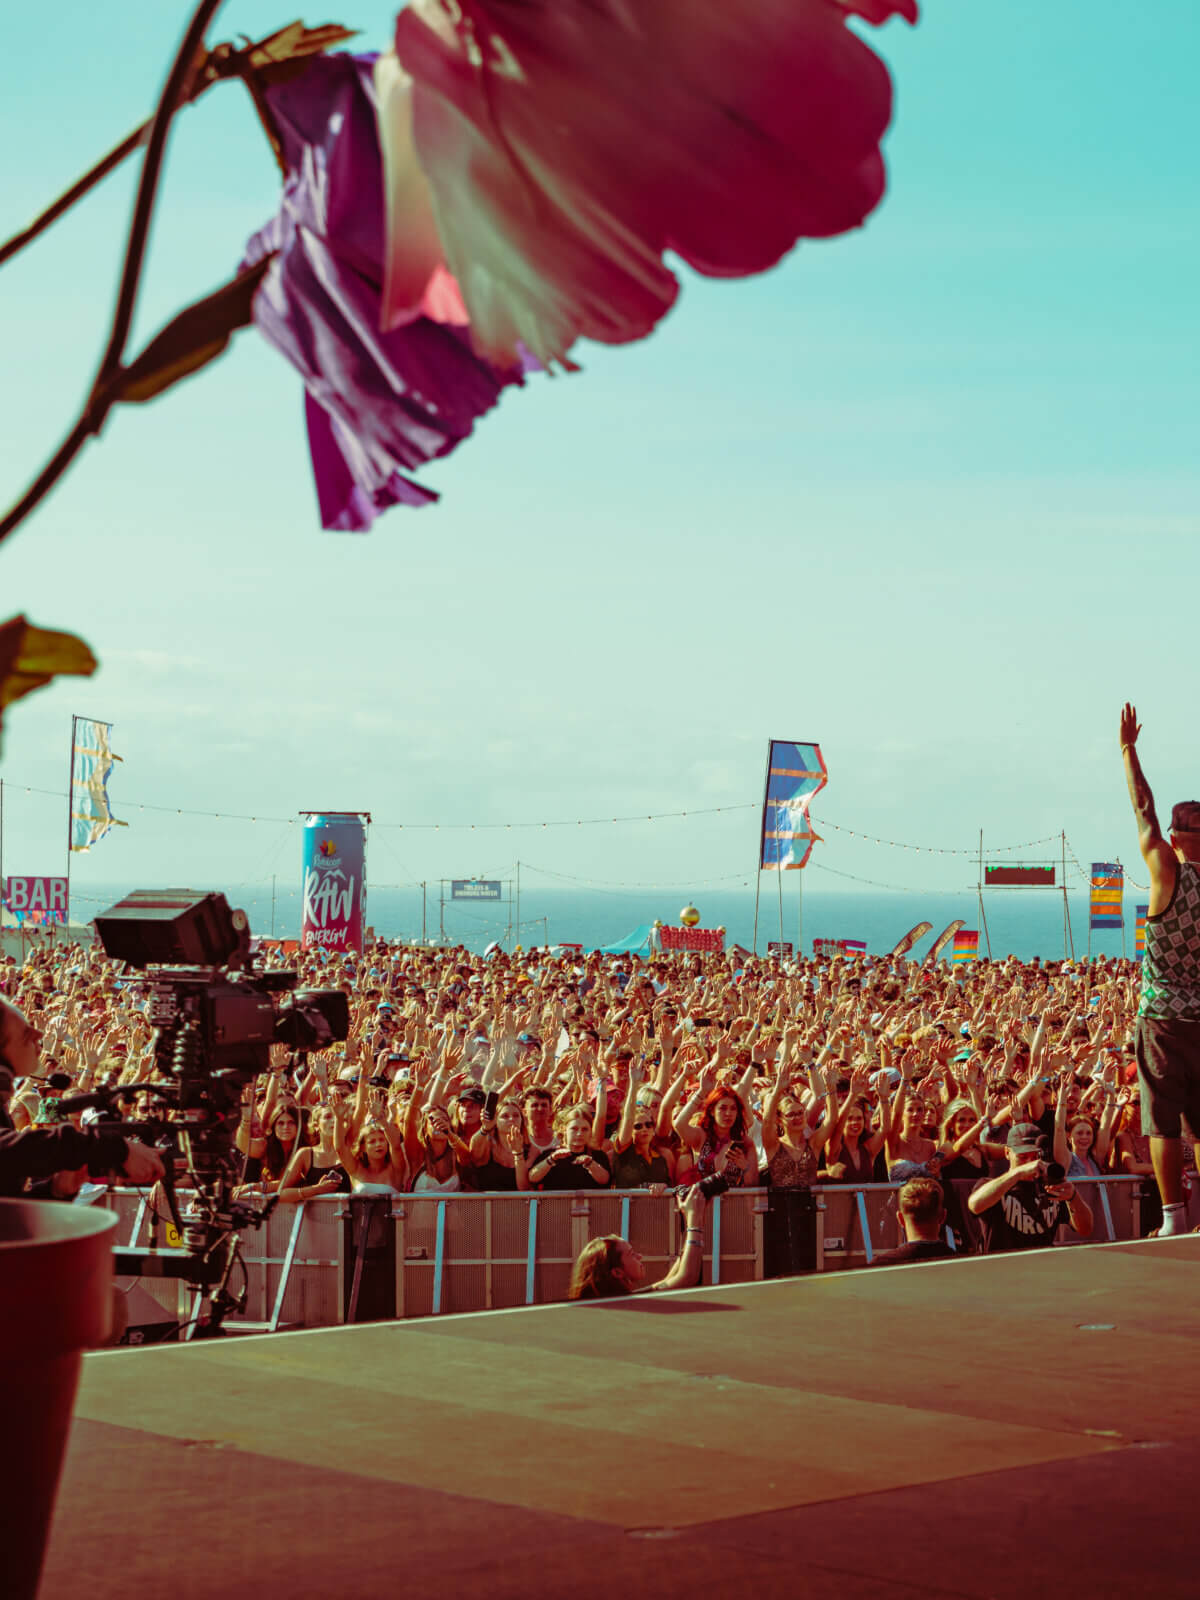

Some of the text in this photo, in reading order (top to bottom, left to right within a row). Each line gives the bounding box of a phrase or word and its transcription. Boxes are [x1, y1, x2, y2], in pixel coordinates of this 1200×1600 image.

[11, 879, 66, 909] BAR
[304, 866, 354, 927] RAW
[305, 926, 348, 946] ENERGY
